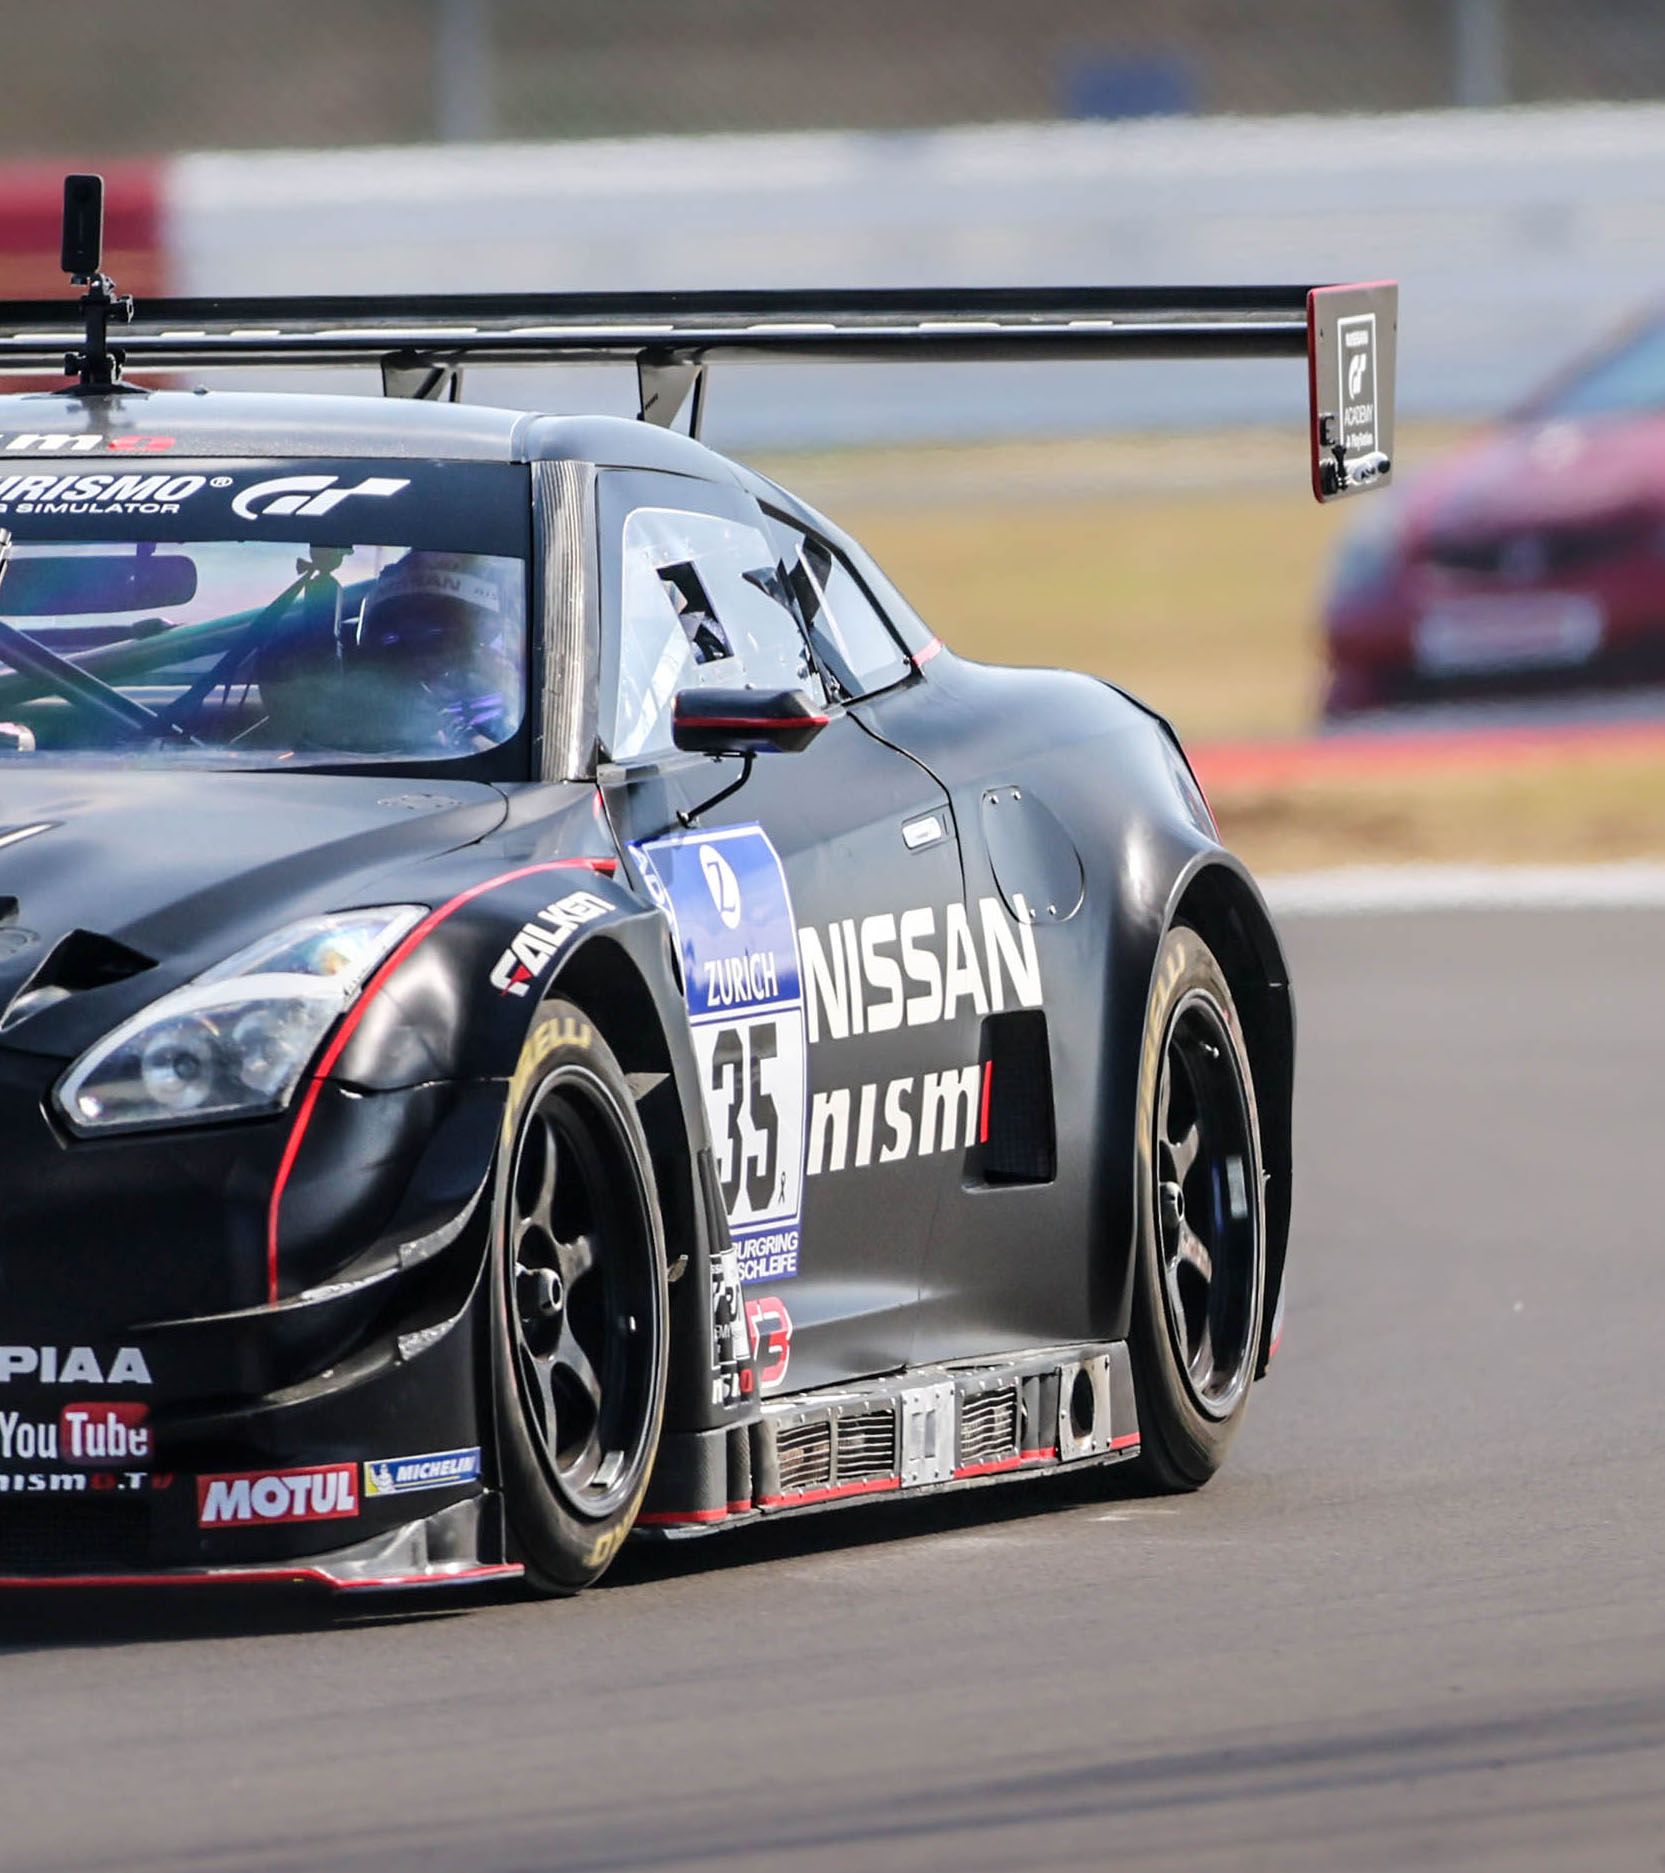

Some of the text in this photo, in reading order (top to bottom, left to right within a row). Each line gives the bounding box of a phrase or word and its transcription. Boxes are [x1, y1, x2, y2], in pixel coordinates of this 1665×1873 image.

[16, 503, 180, 514] SIMULATOR
[490, 890, 616, 998] FALKEN
[798, 894, 1044, 1043] NISSAN
[704, 951, 779, 1007] ZURICH
[712, 1021, 779, 1216] 35
[806, 1060, 993, 1176] nism
[738, 1252, 798, 1280] SCHLEIFE
[200, 1470, 354, 1523] MOTUL
[395, 1454, 475, 1483] MICHELIN
